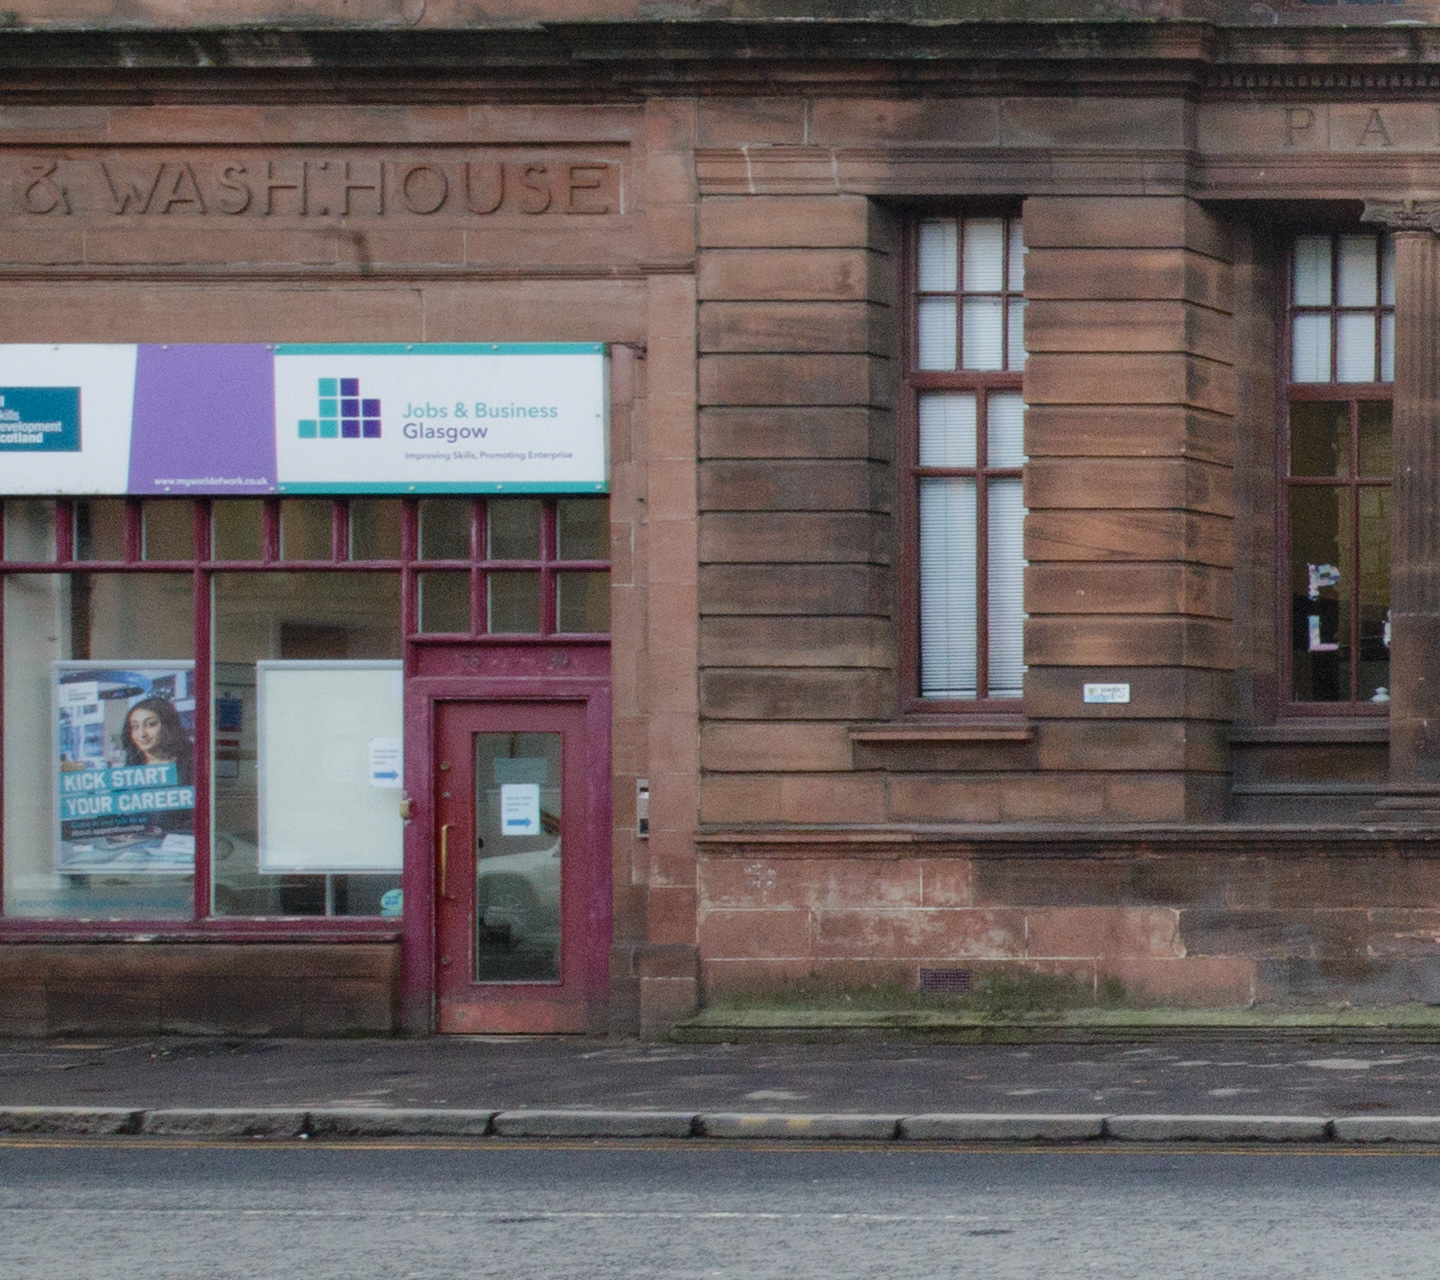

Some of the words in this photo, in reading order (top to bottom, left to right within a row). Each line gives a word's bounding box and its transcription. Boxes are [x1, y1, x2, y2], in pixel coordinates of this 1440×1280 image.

[24, 161, 73, 216] &
[402, 402, 448, 418] Jobs
[454, 402, 468, 418] &
[475, 402, 558, 418] Business
[0, 421, 62, 433] evelopment
[403, 423, 488, 443] Glasgow
[0, 433, 43, 443] cotland
[405, 452, 450, 461] Improving
[480, 451, 526, 461] Promoting
[528, 451, 573, 460] Enterprise
[63, 772, 107, 791] KICK
[111, 766, 170, 788] START
[66, 795, 113, 816] YOUR
[118, 789, 193, 811] CAREER
